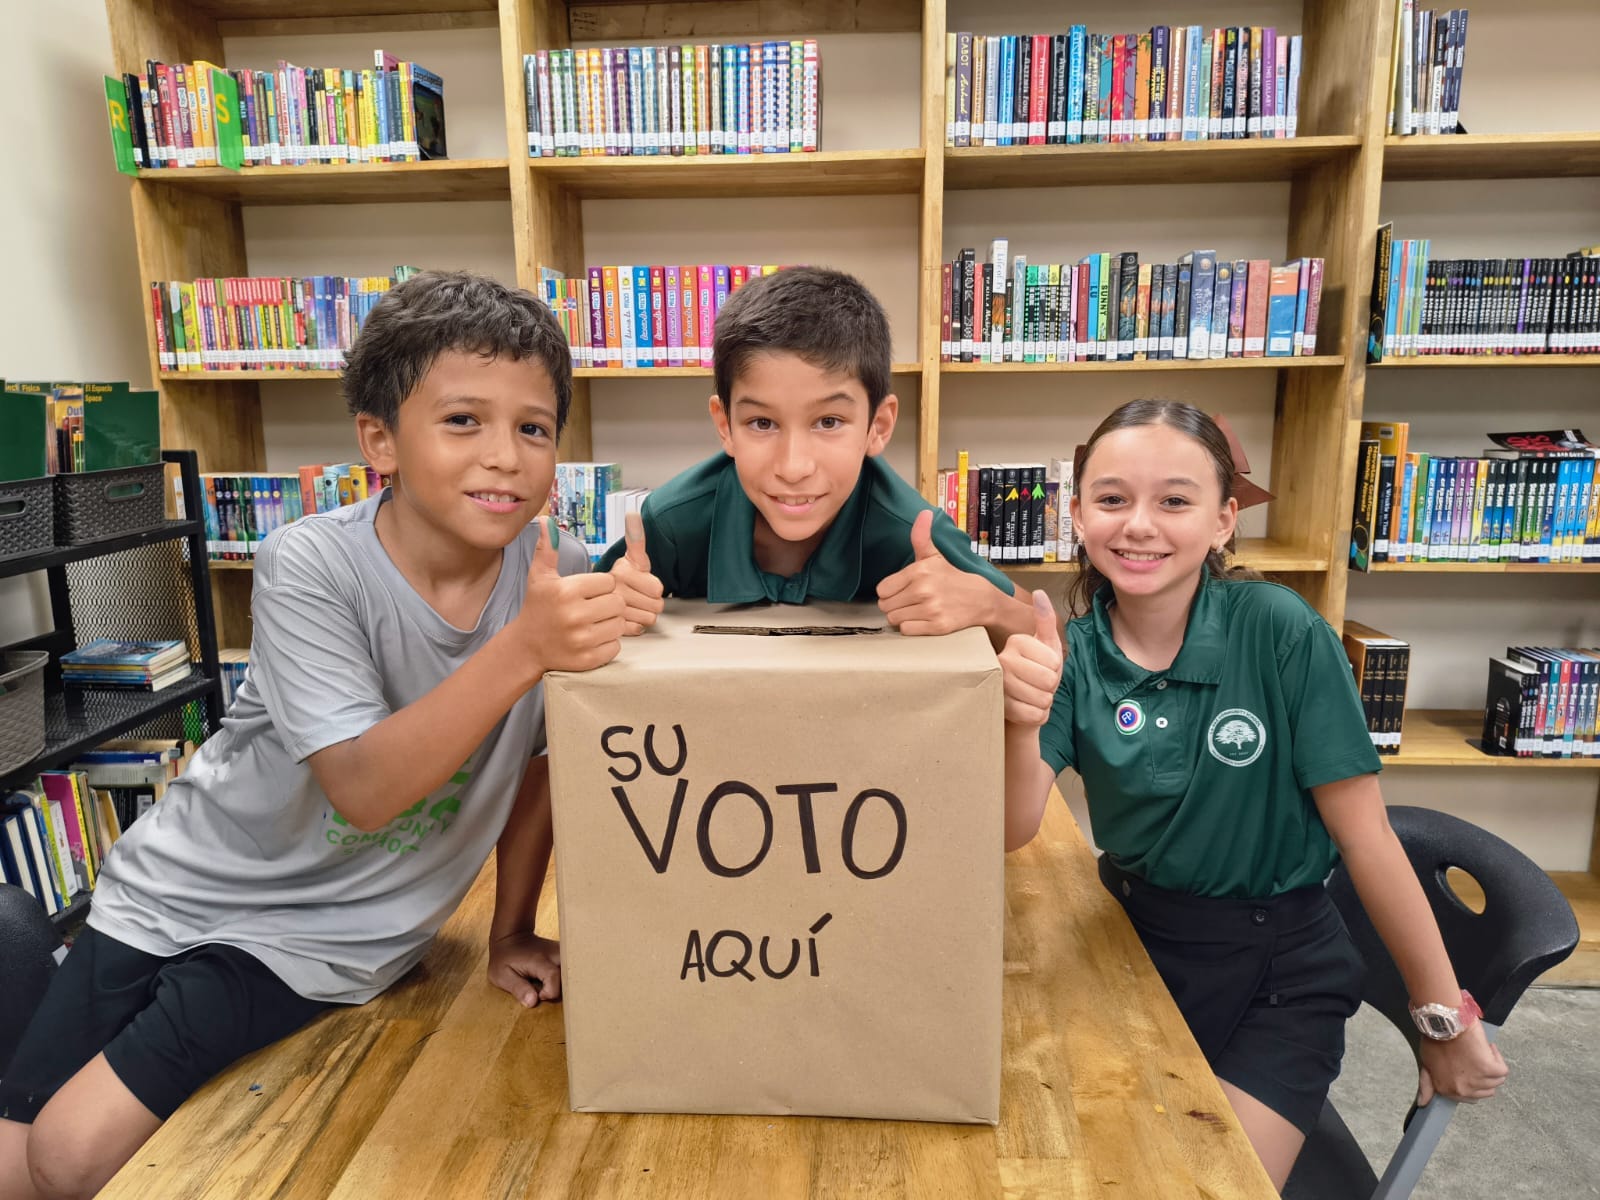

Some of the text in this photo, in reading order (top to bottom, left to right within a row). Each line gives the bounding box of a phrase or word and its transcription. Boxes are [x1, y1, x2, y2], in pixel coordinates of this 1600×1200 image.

[961, 35, 969, 67] CABOT
[109, 99, 127, 133] R
[215, 93, 231, 124] S
[1090, 285, 1097, 298] LU
[1100, 285, 1108, 316] SUNNY
[600, 723, 688, 783] SU
[611, 778, 908, 880] VOTO
[680, 912, 833, 983] AQUÍ
